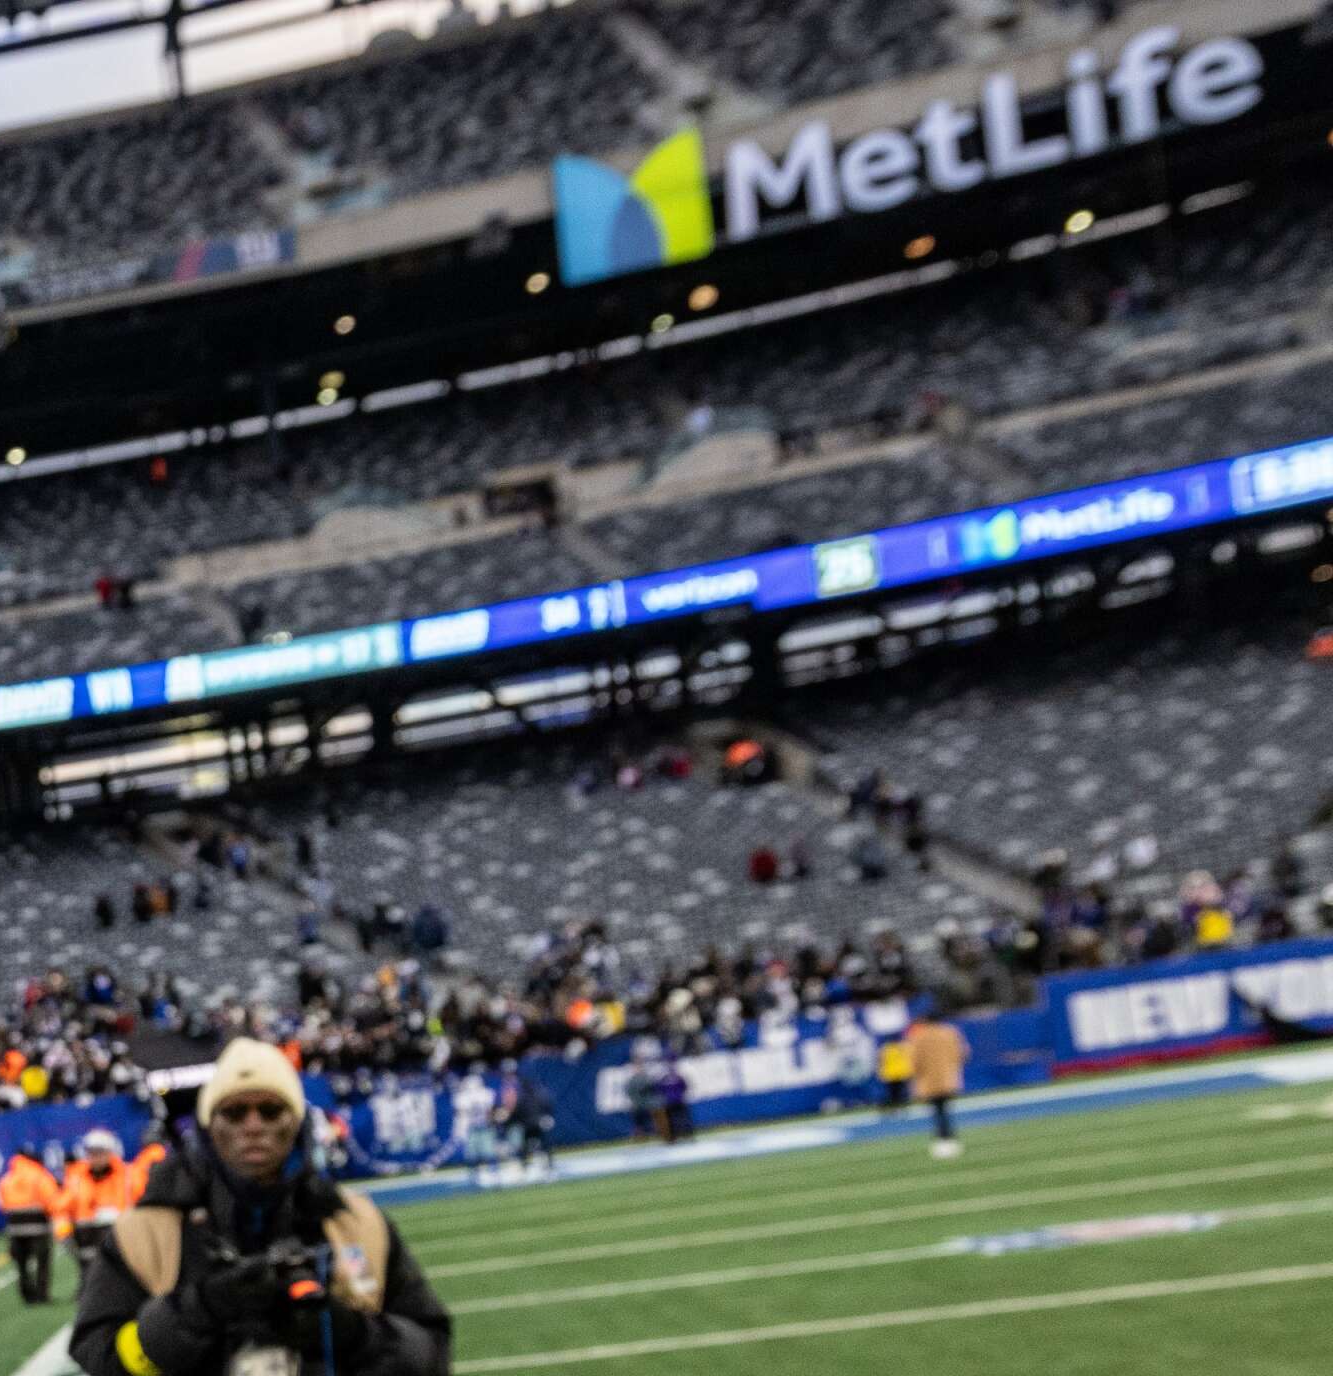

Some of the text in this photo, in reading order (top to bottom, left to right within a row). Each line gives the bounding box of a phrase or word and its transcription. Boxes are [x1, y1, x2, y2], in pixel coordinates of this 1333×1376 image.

[723, 26, 1265, 243] MetLife
[1019, 488, 1175, 545] MetLife
[1067, 970, 1230, 1053] NEW
